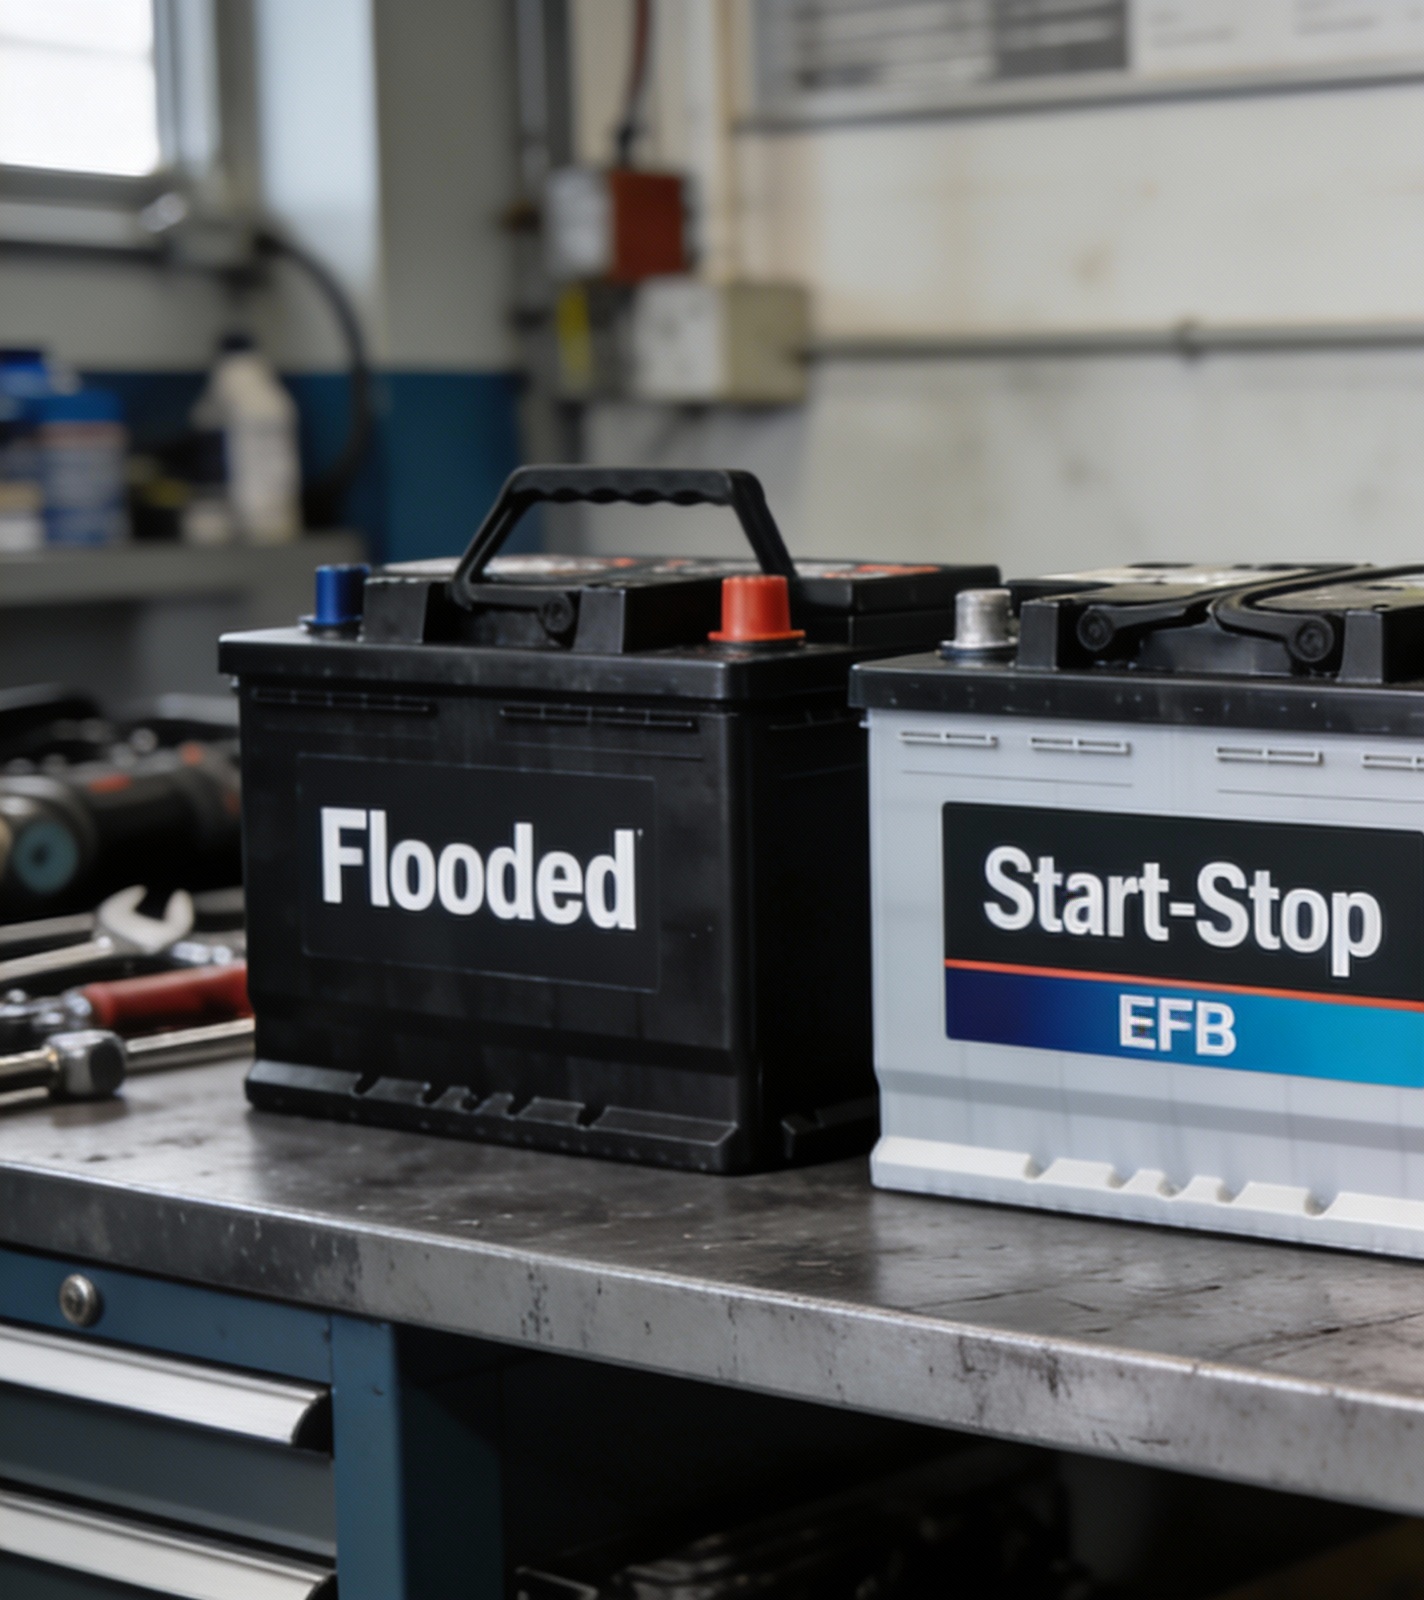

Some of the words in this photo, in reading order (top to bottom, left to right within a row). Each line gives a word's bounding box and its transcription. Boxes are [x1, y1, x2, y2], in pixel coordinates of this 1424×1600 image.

[320, 806, 637, 930] Flooded
[983, 846, 1382, 977] Start-Stop
[1118, 994, 1237, 1057] EFB
